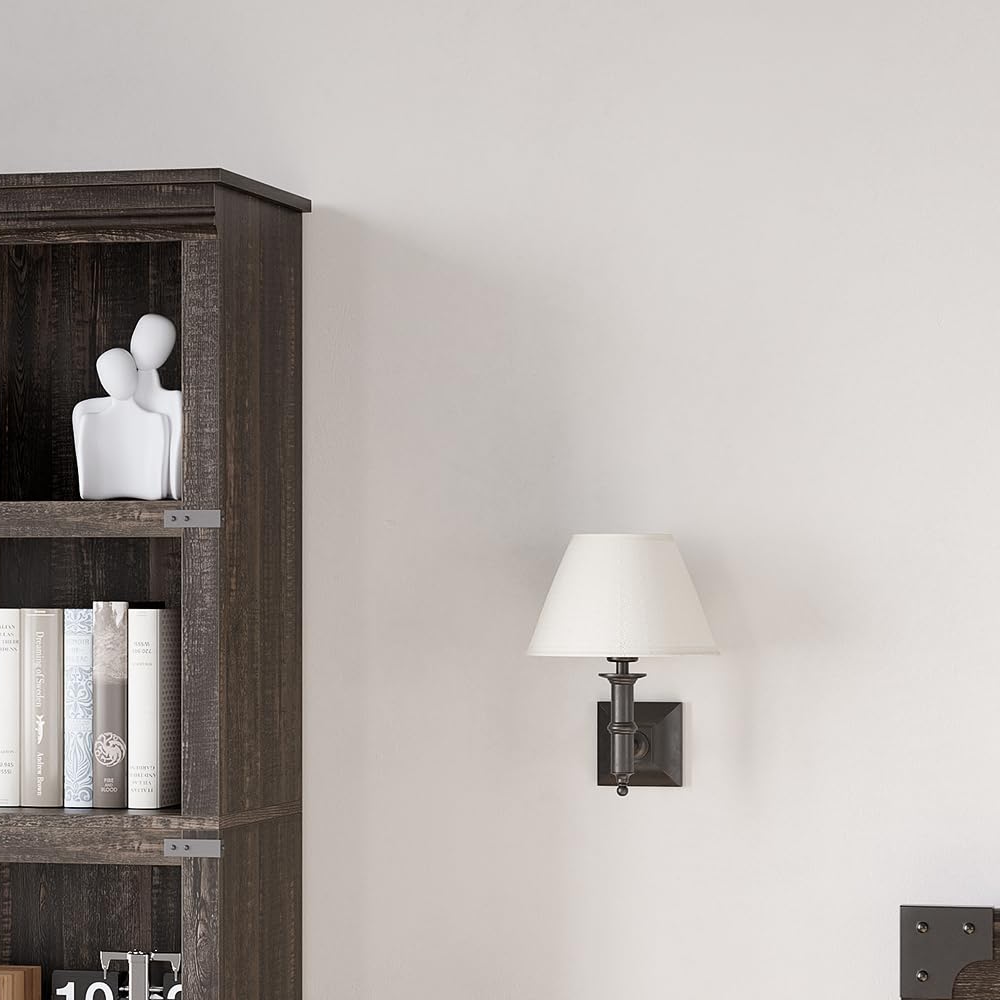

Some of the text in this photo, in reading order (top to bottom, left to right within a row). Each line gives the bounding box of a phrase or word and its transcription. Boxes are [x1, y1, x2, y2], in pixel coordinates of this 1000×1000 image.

[34, 631, 45, 707] Dreaming of Sweden
[36, 752, 45, 796] Andrew Brown
